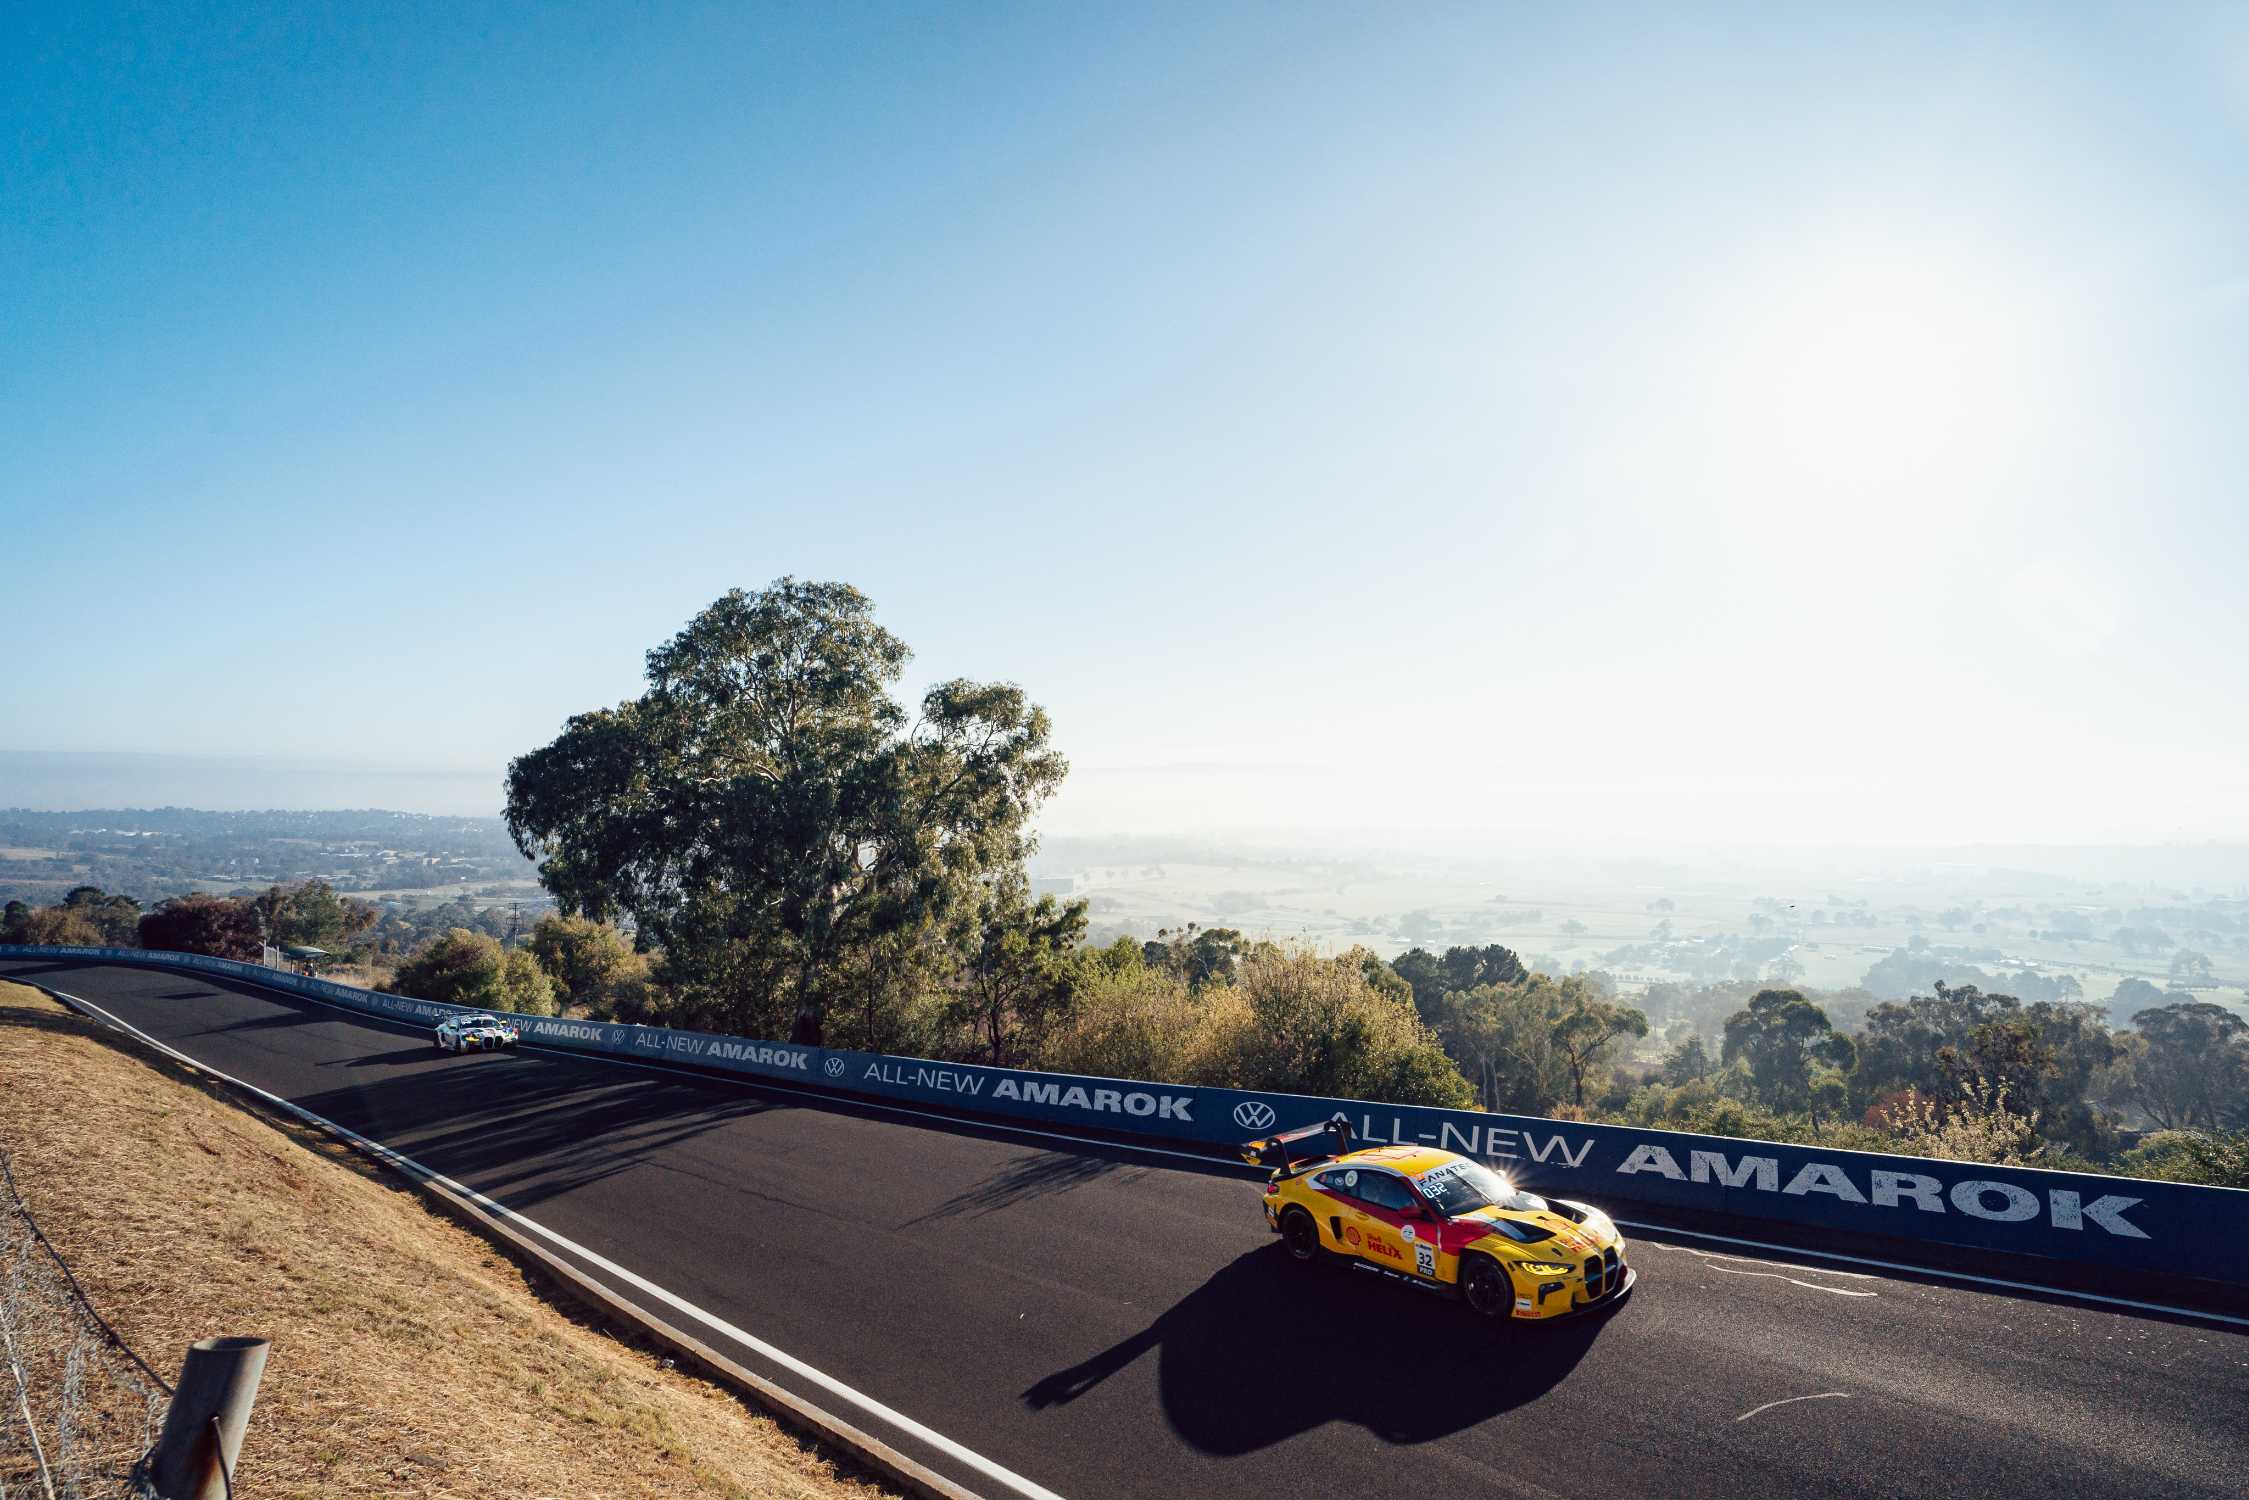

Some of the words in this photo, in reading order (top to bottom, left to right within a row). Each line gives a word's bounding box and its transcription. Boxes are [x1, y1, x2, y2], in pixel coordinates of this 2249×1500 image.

[533, 1022, 603, 1041] AMAROK
[635, 1031, 704, 1055] ALL-NEW
[706, 1041, 808, 1070] AMAROK
[863, 1062, 985, 1096] ALL-NEW
[991, 1078, 1195, 1123] AMAROK
[1233, 1101, 1276, 1130] VW
[1422, 1182, 1448, 1199] 032
[1615, 1144, 2153, 1240] AMAROK
[1367, 1239, 1403, 1260] HELIX
[1418, 1252, 1432, 1267] 32
